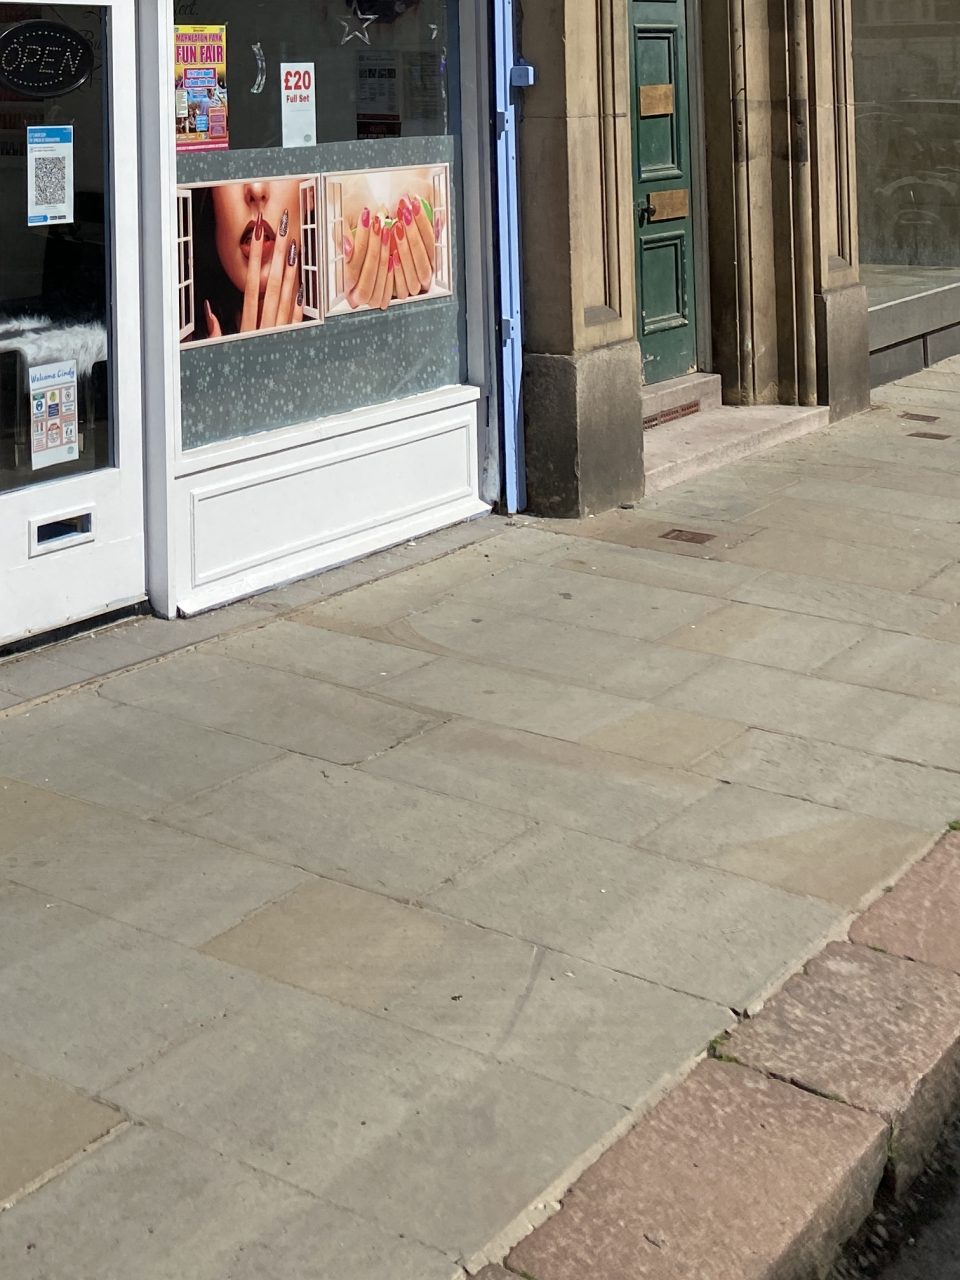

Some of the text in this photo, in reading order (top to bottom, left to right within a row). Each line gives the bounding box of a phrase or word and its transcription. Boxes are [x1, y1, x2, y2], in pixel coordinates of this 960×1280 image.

[1, 44, 84, 75] OPEN
[176, 44, 224, 64] FUN FAIR
[284, 70, 312, 91] £20
[286, 94, 310, 104] Full Set
[31, 367, 75, 383] Welcome Cindy
